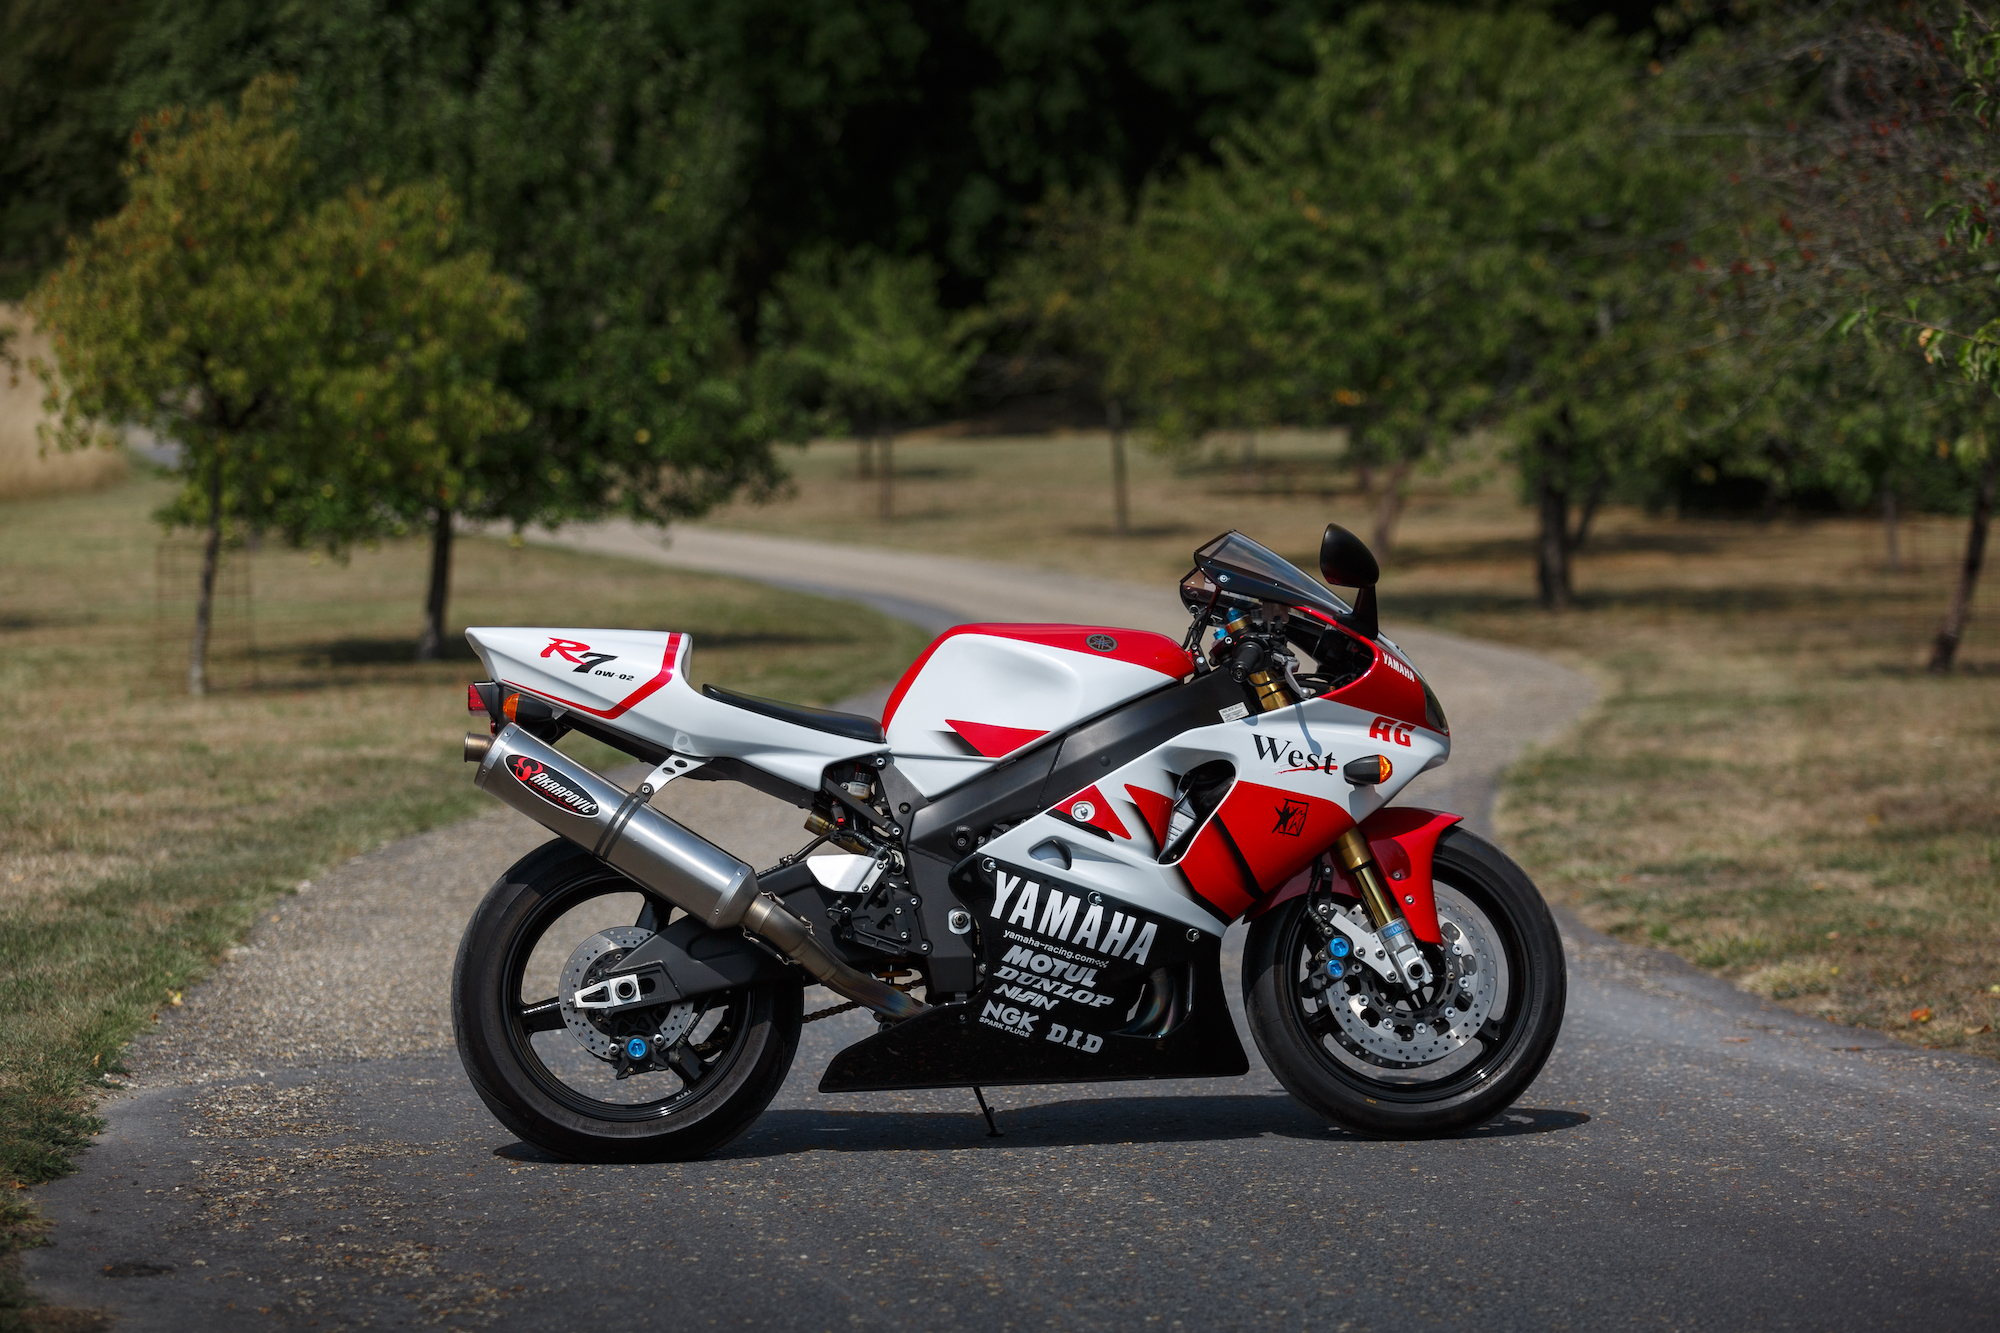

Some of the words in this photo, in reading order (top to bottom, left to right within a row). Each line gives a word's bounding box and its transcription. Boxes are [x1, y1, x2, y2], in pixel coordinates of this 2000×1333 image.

[540, 637, 619, 674] R7
[1382, 652, 1415, 683] YAMAHA
[1252, 733, 1336, 775] West
[990, 869, 1158, 966] YAMAHA
[1002, 928, 1096, 964] yamaha-racing.com
[1001, 944, 1099, 988] MOTUL
[993, 965, 1115, 1008] DUNLOP
[978, 1016, 1004, 1032] SPARK
[1004, 1024, 1031, 1038] PLUGS
[981, 999, 1040, 1033] NGK
[1045, 1022, 1104, 1054] D.I.D
